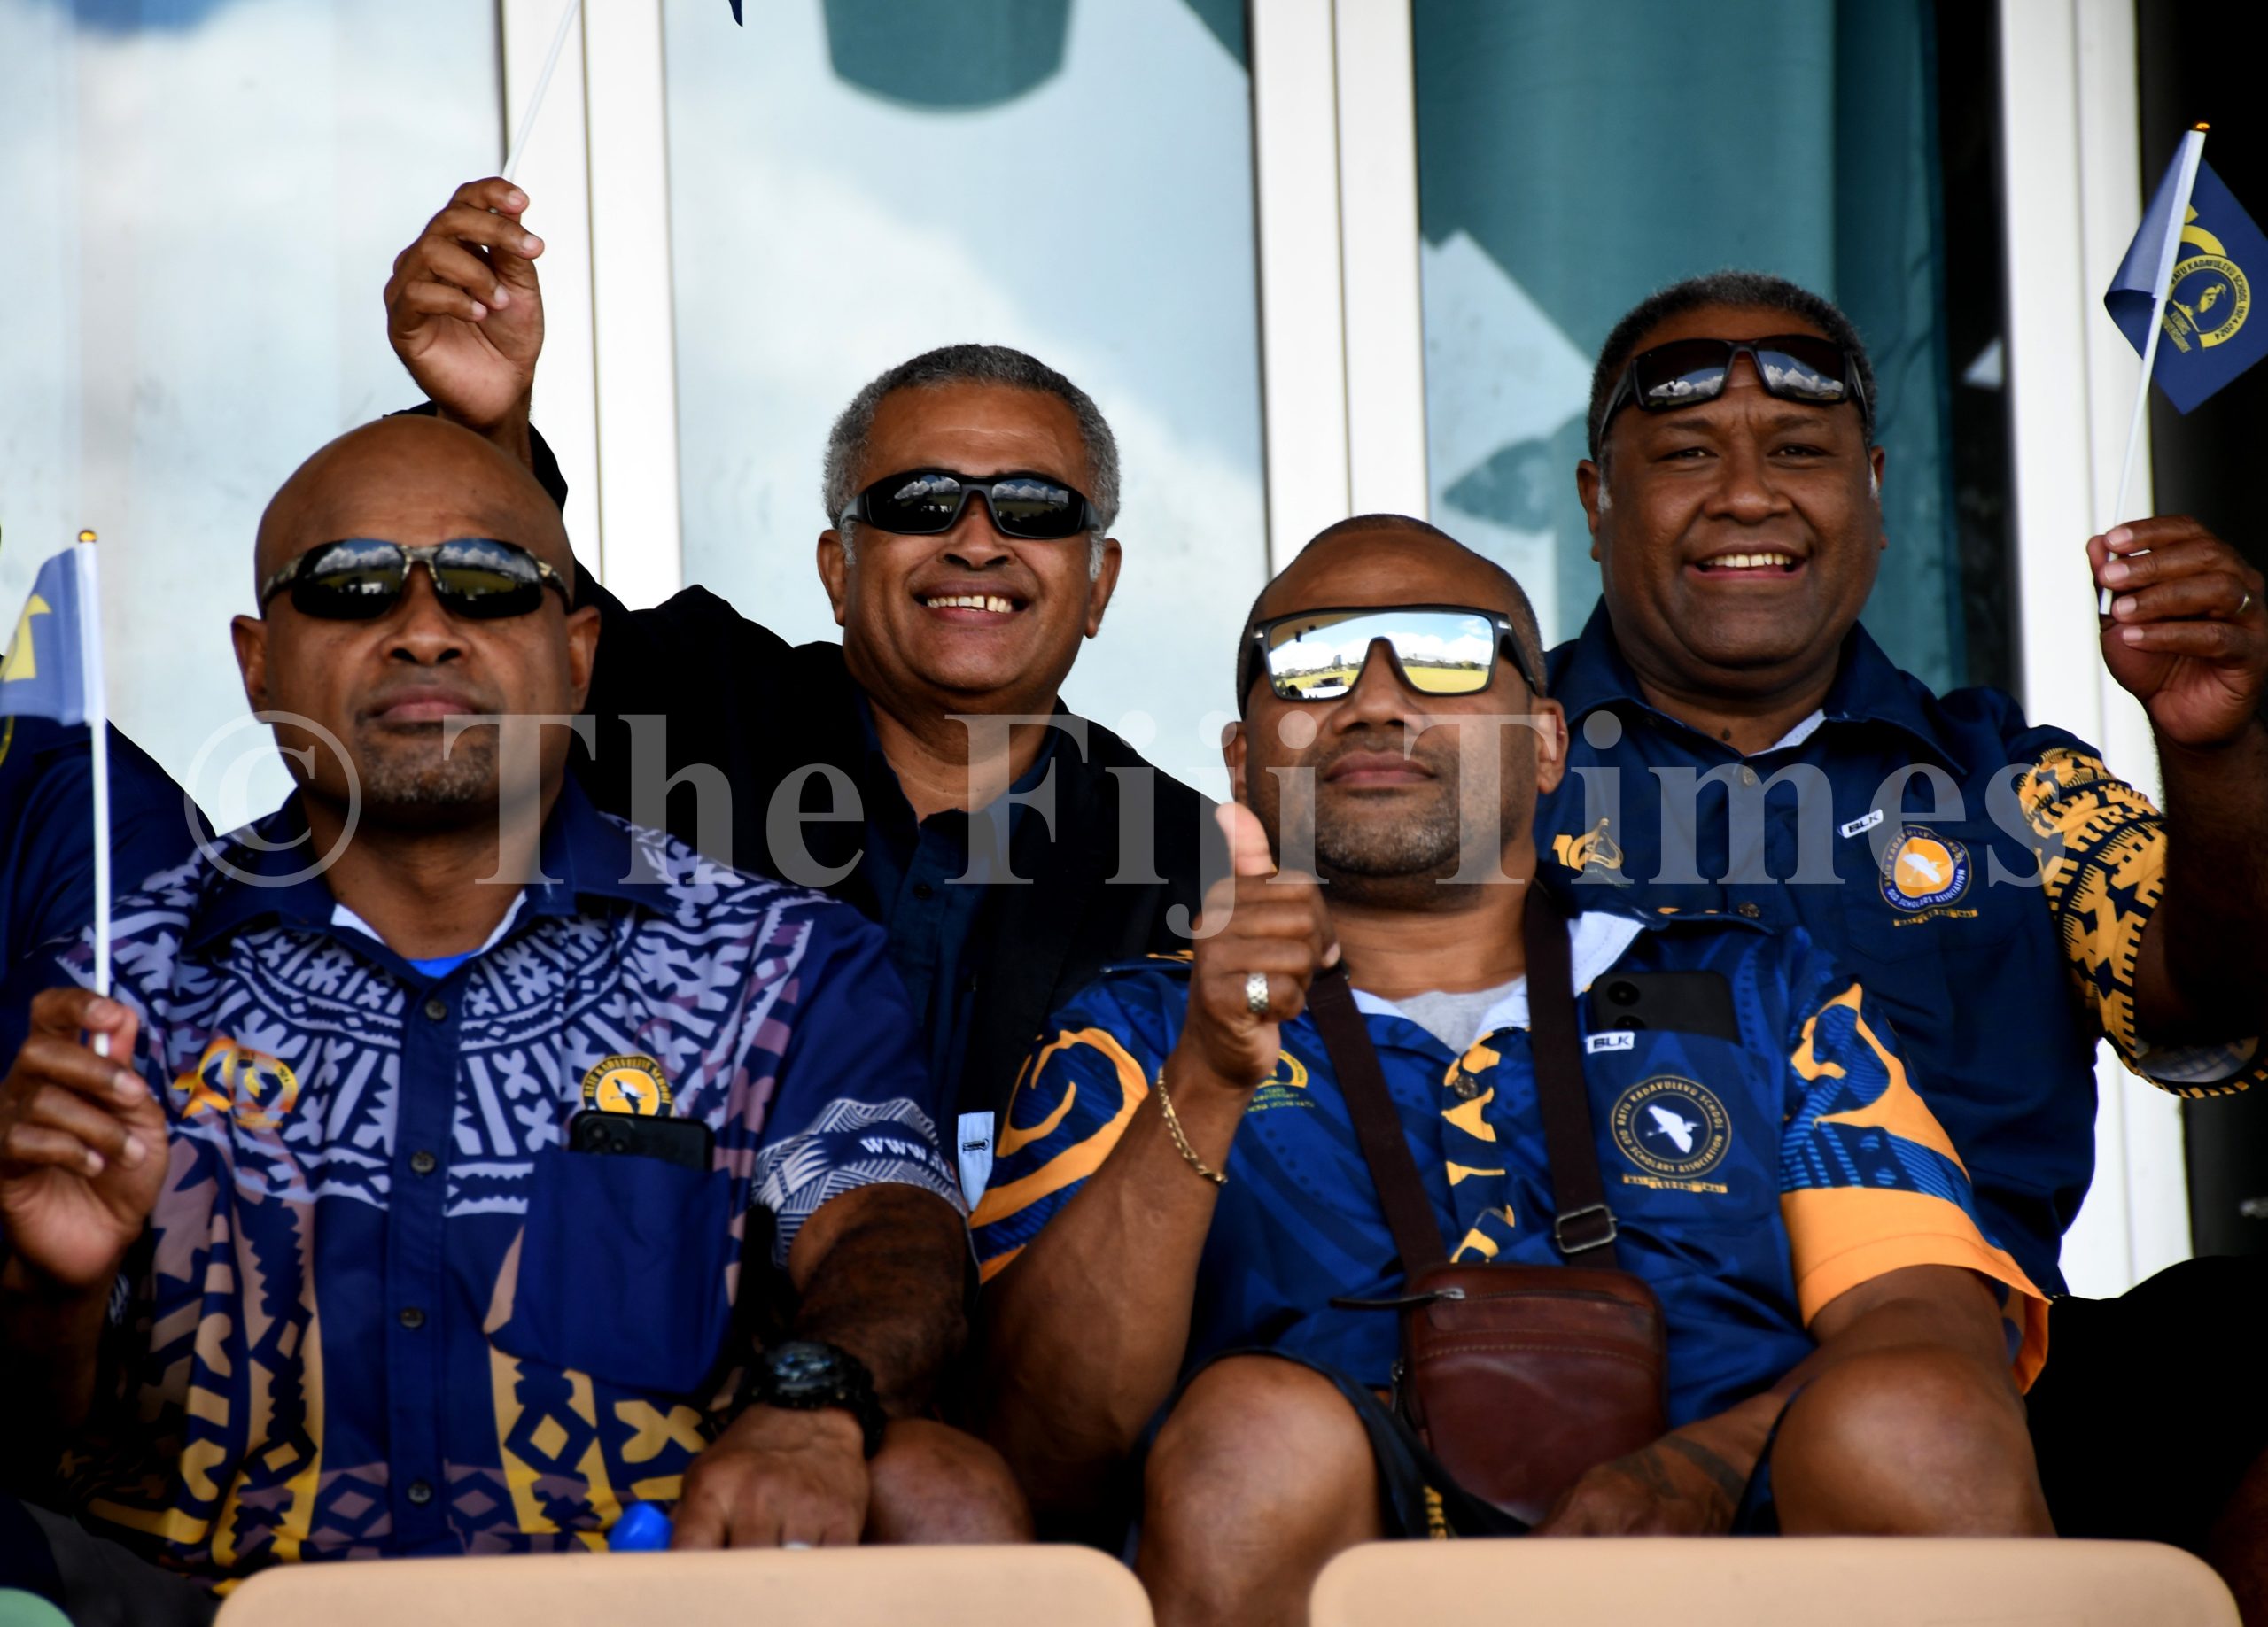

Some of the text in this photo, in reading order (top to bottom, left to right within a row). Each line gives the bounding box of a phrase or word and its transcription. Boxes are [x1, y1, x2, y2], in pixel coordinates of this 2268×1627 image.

[2233, 275, 2248, 303] SCHOOL
[1848, 812, 1879, 833] BLK
[1593, 1036, 1630, 1049] BLK
[1617, 1081, 1724, 1129] RATU KADAVULEVU SCHOOL
[1630, 1146, 1674, 1172] SCHOLARS
[1678, 1135, 1723, 1173] ASSOCIATION
